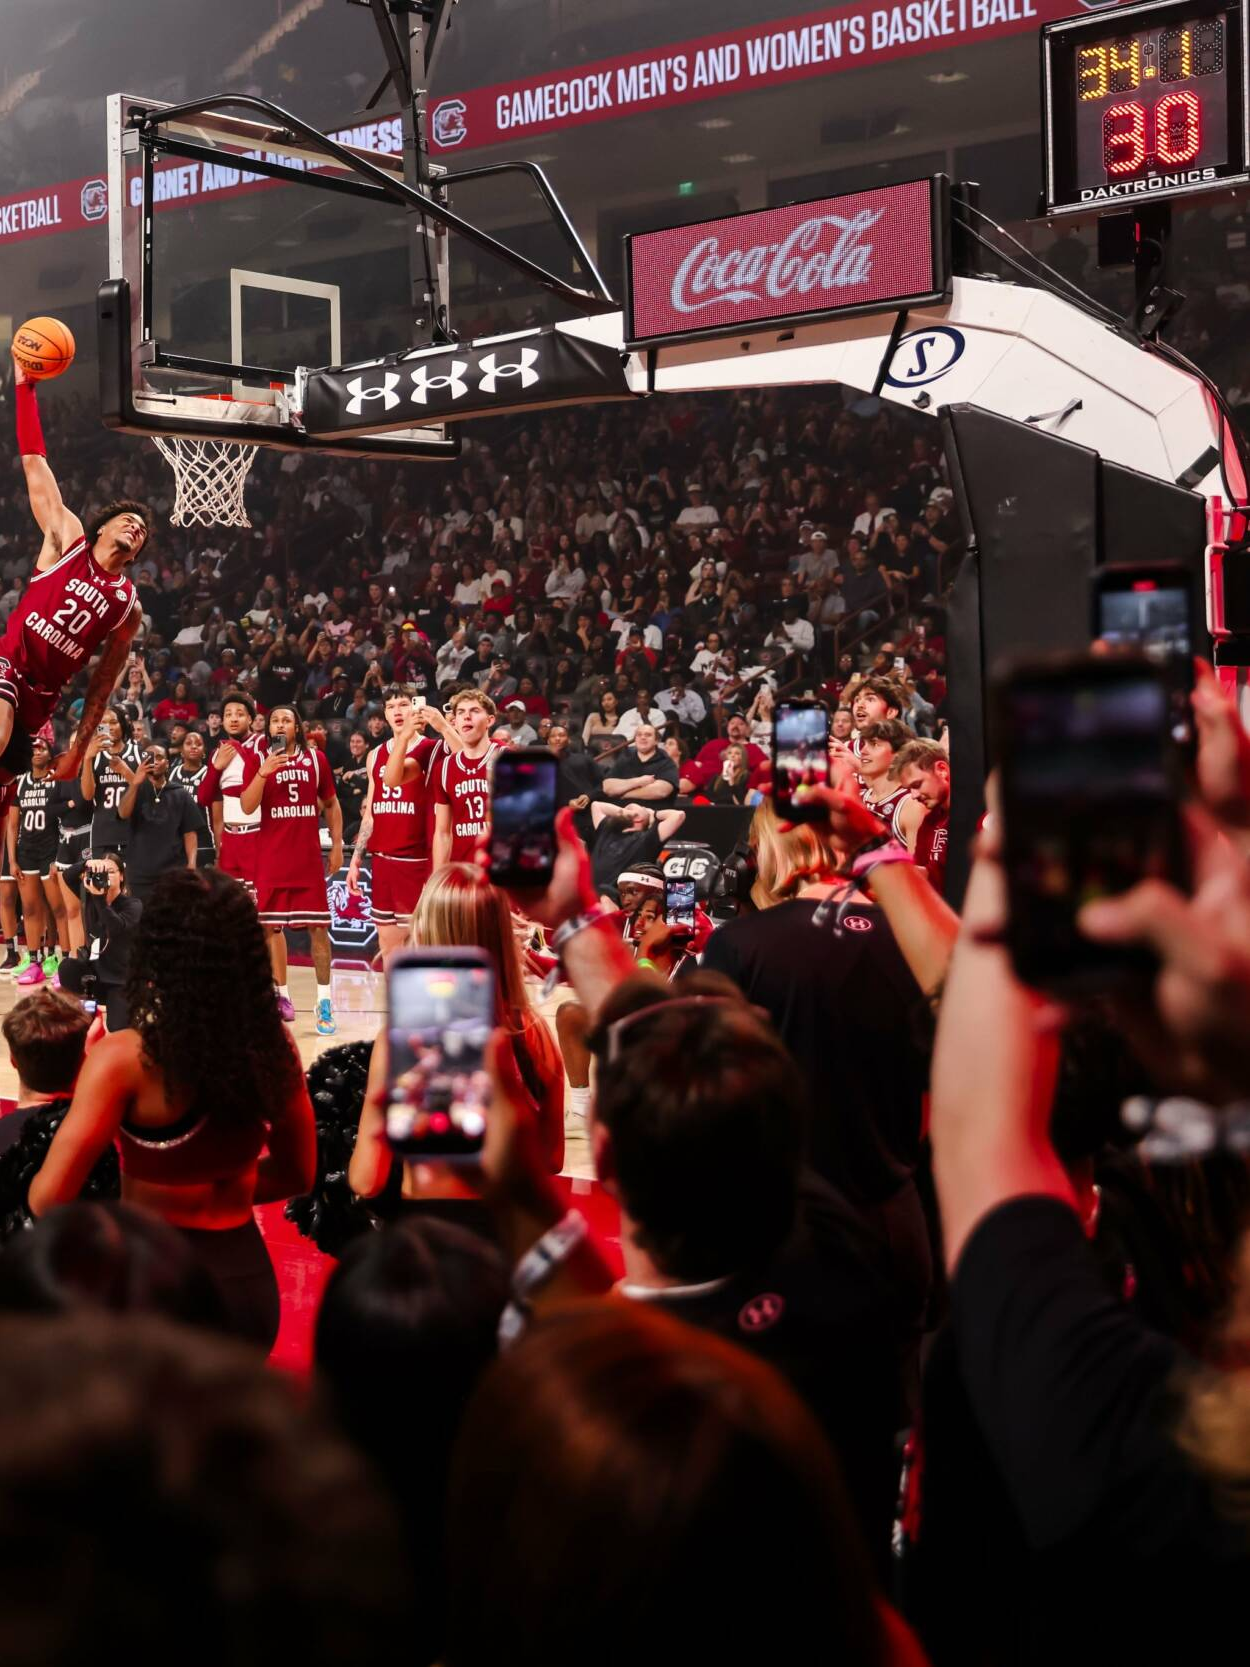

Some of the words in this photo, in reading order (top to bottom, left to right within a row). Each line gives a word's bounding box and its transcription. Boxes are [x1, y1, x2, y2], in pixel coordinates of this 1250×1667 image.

[496, 71, 613, 130] GAMECOCK
[617, 55, 688, 105] MEN'S
[693, 43, 741, 88] AND
[746, 15, 865, 76] WOMEN'S
[1108, 92, 1199, 173] 30
[130, 163, 200, 207] GRNET
[1081, 168, 1216, 201] DAKTRONICS
[64, 578, 110, 619] SOUTH
[52, 598, 92, 635] 20
[25, 611, 85, 660] CAROLINA
[276, 769, 310, 784] SOUTH
[25, 788, 46, 798] SOUTH
[288, 783, 299, 803] 5
[454, 779, 489, 798] SOUTH
[271, 805, 316, 818] CAROLINA
[373, 801, 415, 815] CAROLINA
[465, 796, 484, 819] 13
[24, 809, 46, 831] 00
